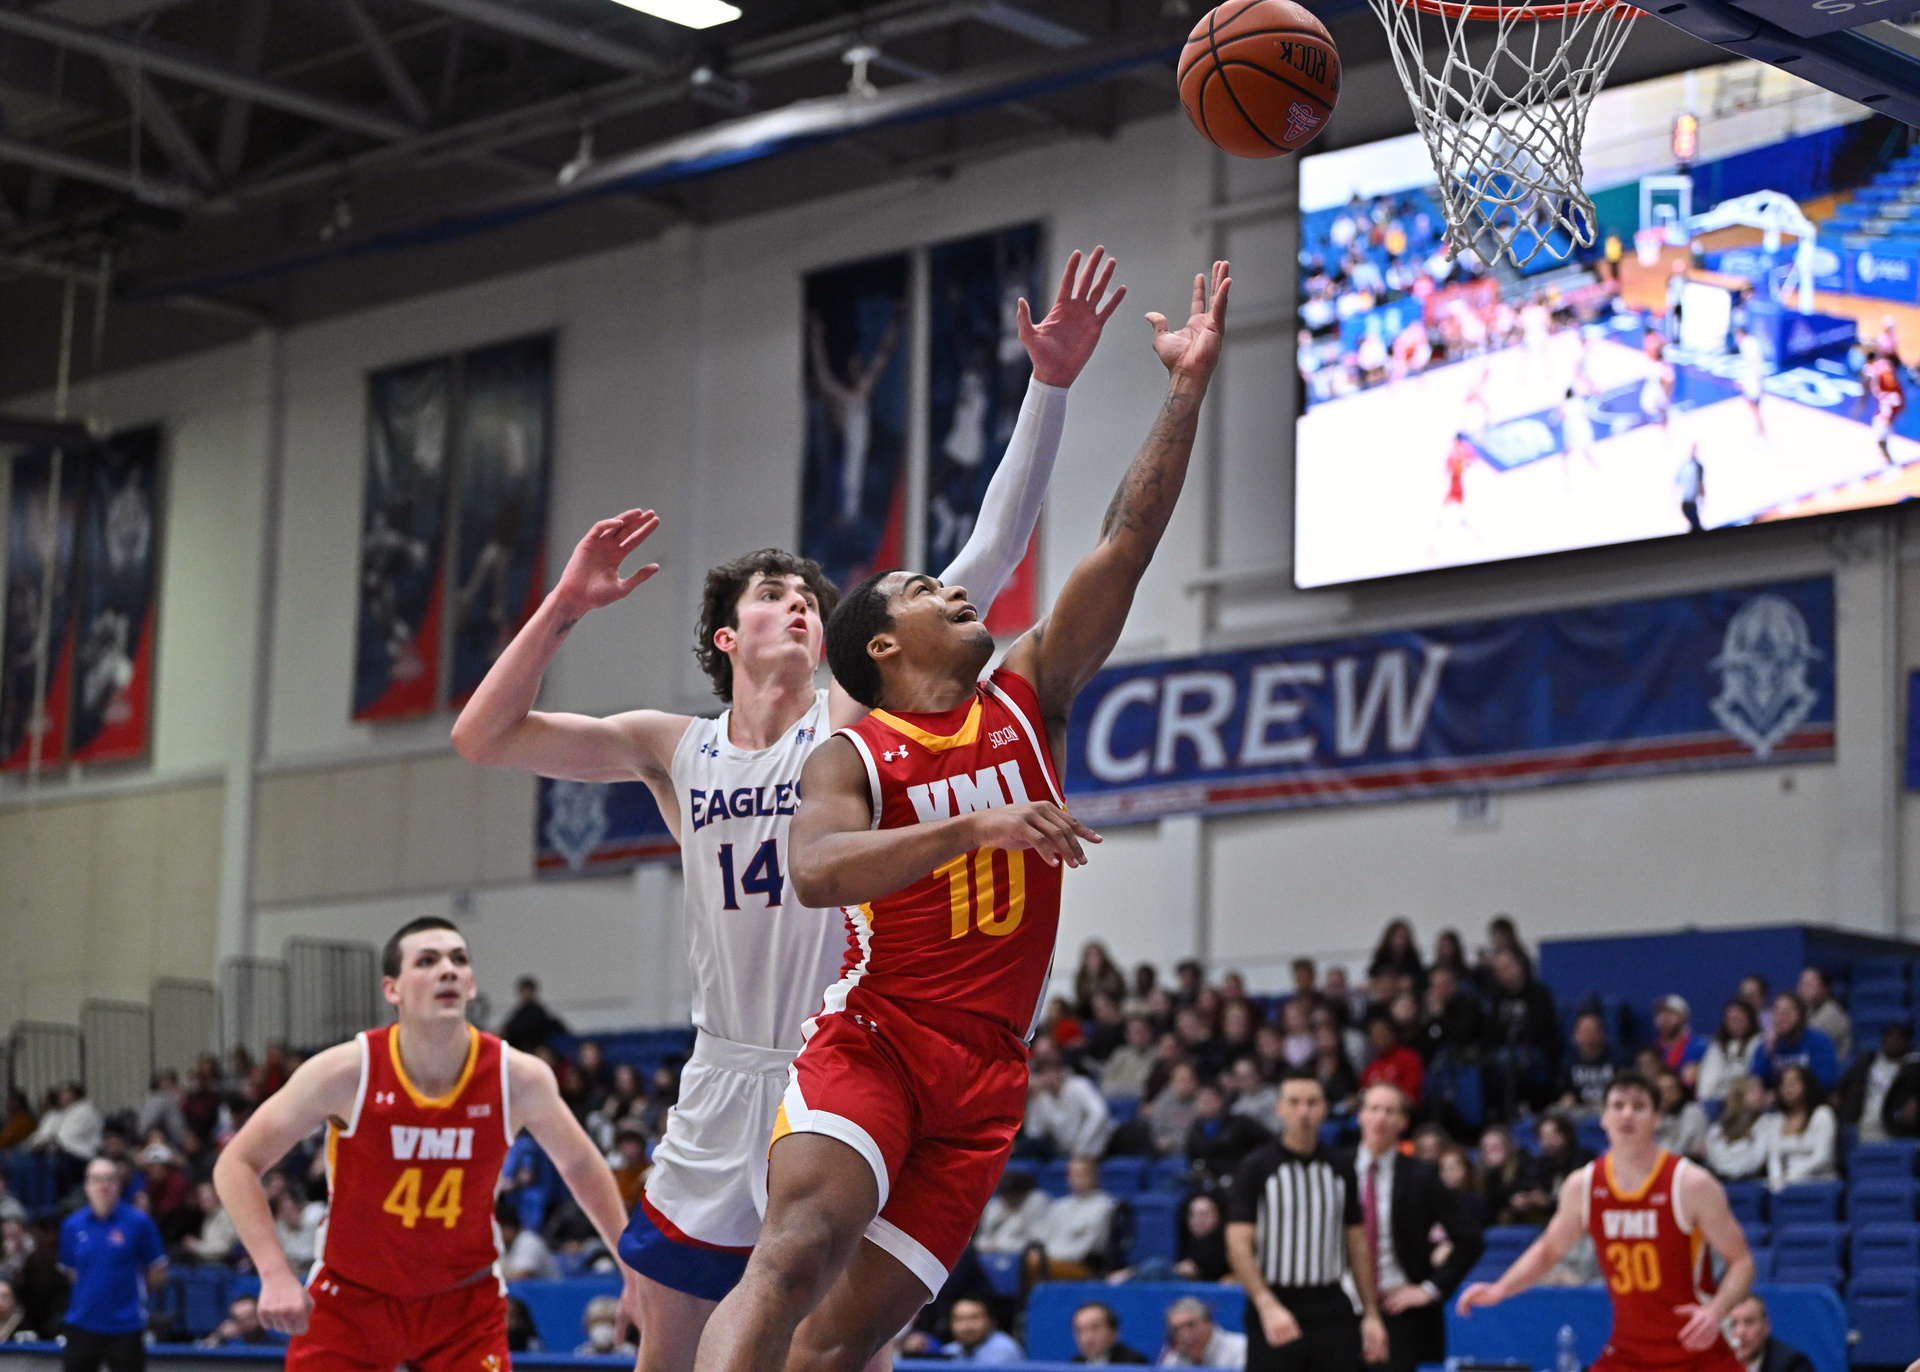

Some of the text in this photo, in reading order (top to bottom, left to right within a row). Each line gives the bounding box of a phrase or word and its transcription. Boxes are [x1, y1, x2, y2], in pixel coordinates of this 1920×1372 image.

[1280, 41, 1327, 84] ROCK
[1290, 105, 1318, 126] AMERICAN
[988, 724, 1019, 749] SOCON
[1085, 644, 1449, 783] CREW
[906, 759, 1030, 823] VMI
[717, 838, 785, 910] 14
[933, 846, 1026, 940] 10
[390, 1124, 475, 1160] VMI
[383, 1167, 464, 1229] 44
[1602, 1209, 1658, 1239] VMI
[1606, 1242, 1661, 1294] 30
